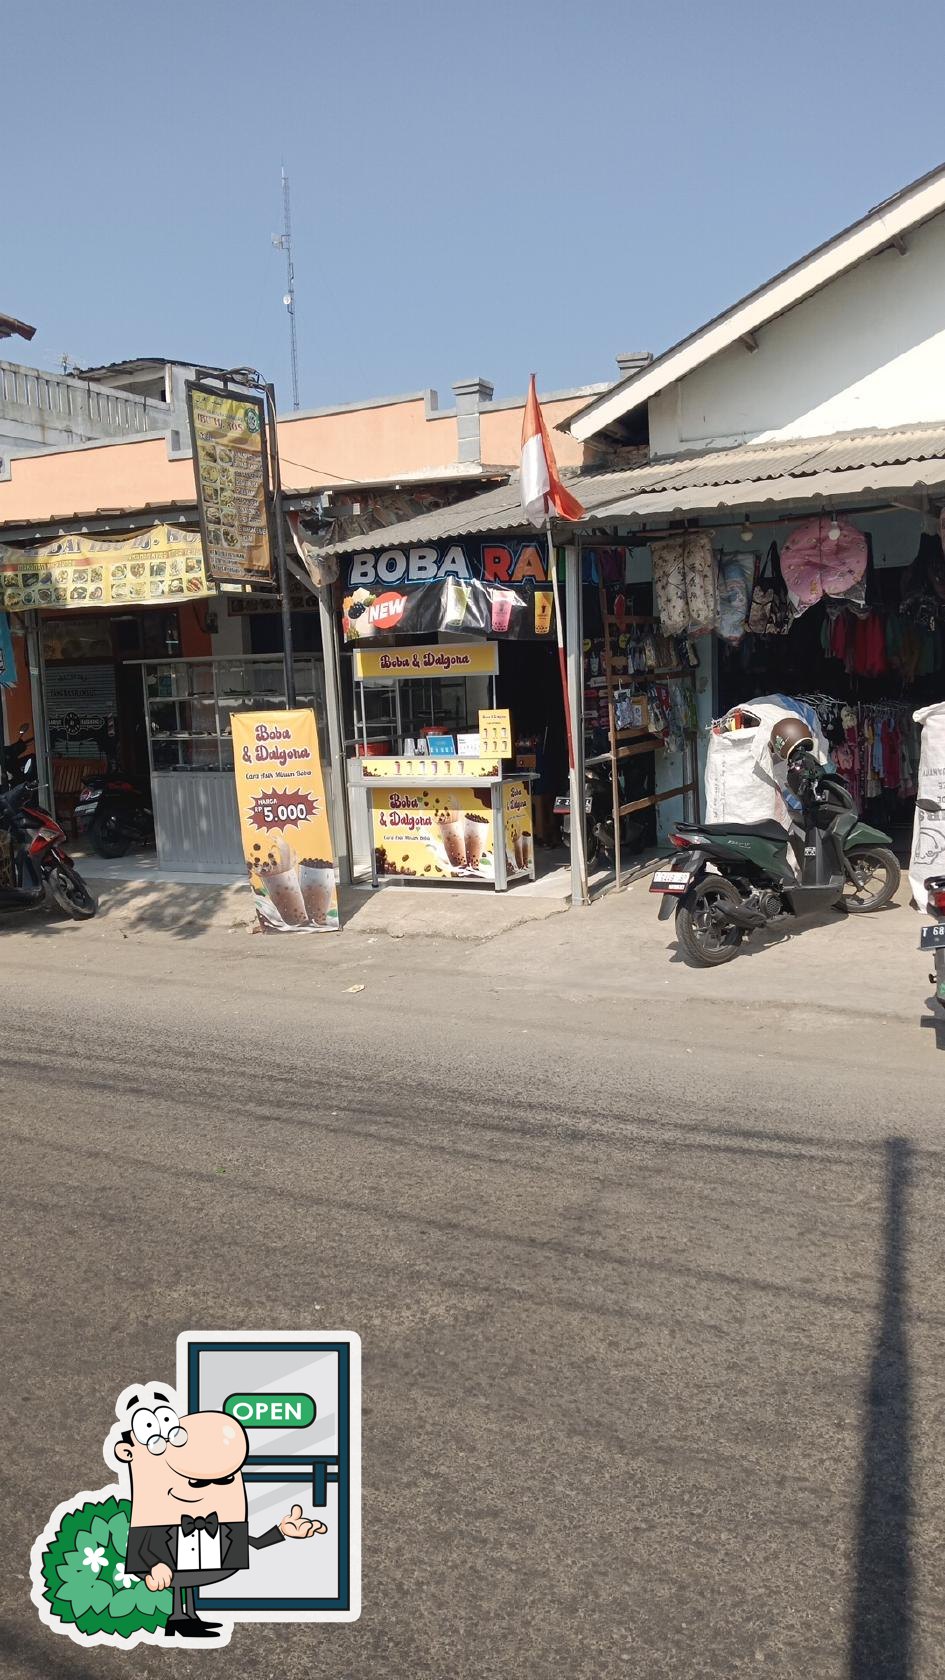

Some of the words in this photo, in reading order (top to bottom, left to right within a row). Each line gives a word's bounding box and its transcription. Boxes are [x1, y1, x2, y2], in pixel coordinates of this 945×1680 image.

[350, 546, 471, 584] BOBA
[368, 596, 407, 623] NEW
[380, 654, 410, 669] Boba
[412, 653, 420, 668] &
[423, 652, 470, 670] Dalgona
[255, 724, 291, 742] Boba
[242, 745, 252, 764] &
[254, 744, 311, 766] Dalgona
[389, 793, 419, 809] Boba
[263, 803, 307, 822] 5.000
[379, 811, 387, 827] &
[389, 810, 433, 831] Dalgona
[922, 927, 928, 938] T
